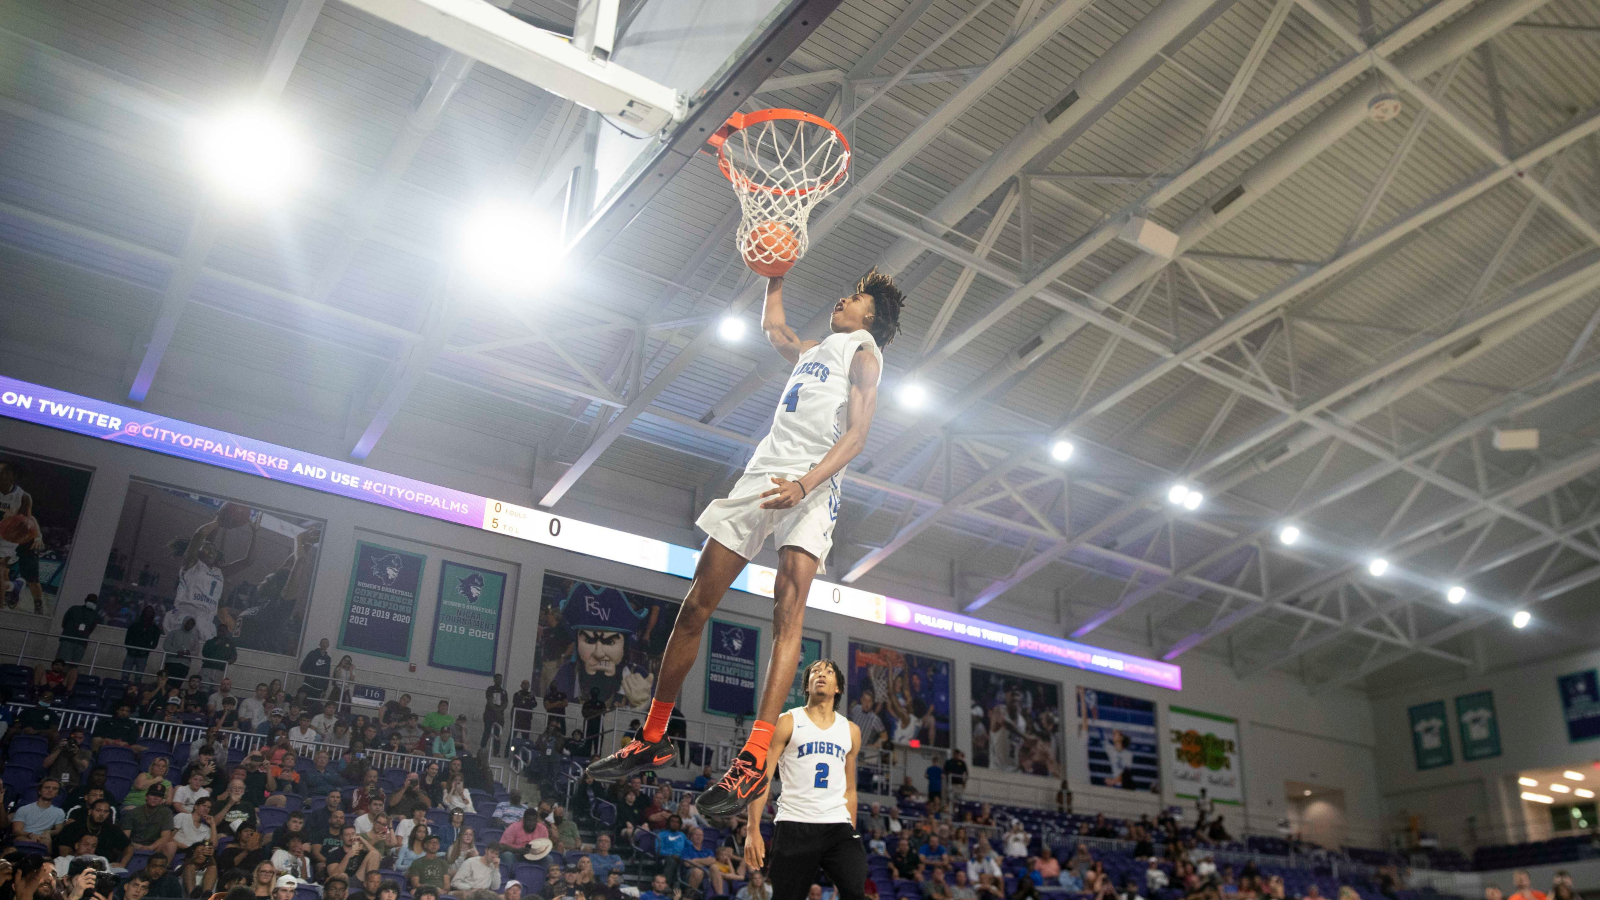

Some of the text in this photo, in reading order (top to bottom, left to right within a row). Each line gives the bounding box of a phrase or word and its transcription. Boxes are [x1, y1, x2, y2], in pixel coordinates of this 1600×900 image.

[792, 361, 830, 383] IGHTS
[782, 382, 804, 412] 4
[2, 391, 469, 515] ON TWITTER @CITYOFPALMSBKB AND USE #CITYOFPALMS
[491, 518, 499, 529] 5
[548, 517, 562, 537] 0
[381, 586, 414, 598] BASKETBALL
[351, 604, 411, 624] 2018 2019 2020
[584, 596, 611, 621] FSW
[349, 615, 368, 627] 2021
[438, 622, 494, 640] 2019 2020
[914, 612, 953, 631] FOLLOW
[365, 688, 380, 699] 116
[797, 741, 846, 763] KNIGHTS
[813, 762, 830, 789] 2
